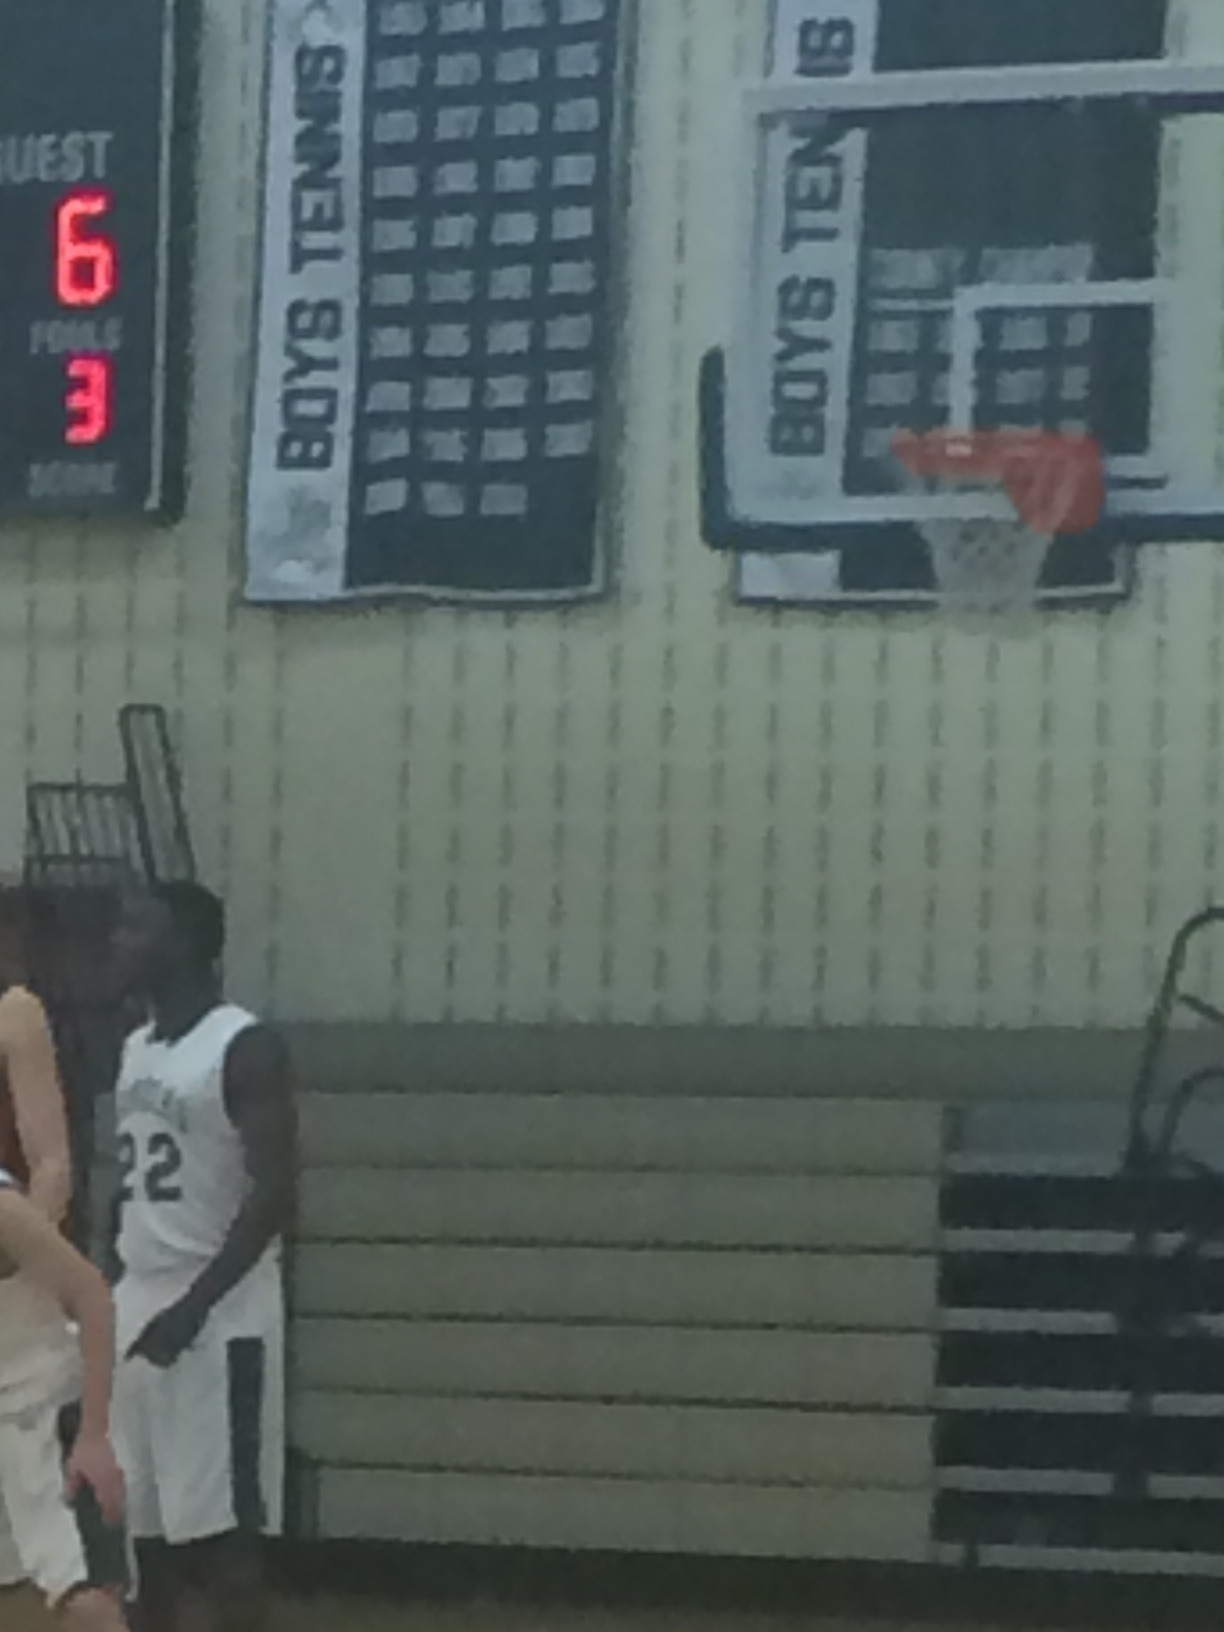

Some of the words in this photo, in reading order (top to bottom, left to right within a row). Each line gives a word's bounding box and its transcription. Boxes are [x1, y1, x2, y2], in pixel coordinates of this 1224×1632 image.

[287, 43, 347, 275] TENNIS
[58, 196, 113, 304] 6
[65, 358, 107, 444] 3
[275, 298, 342, 471] BOYS
[769, 274, 837, 457] BOYS
